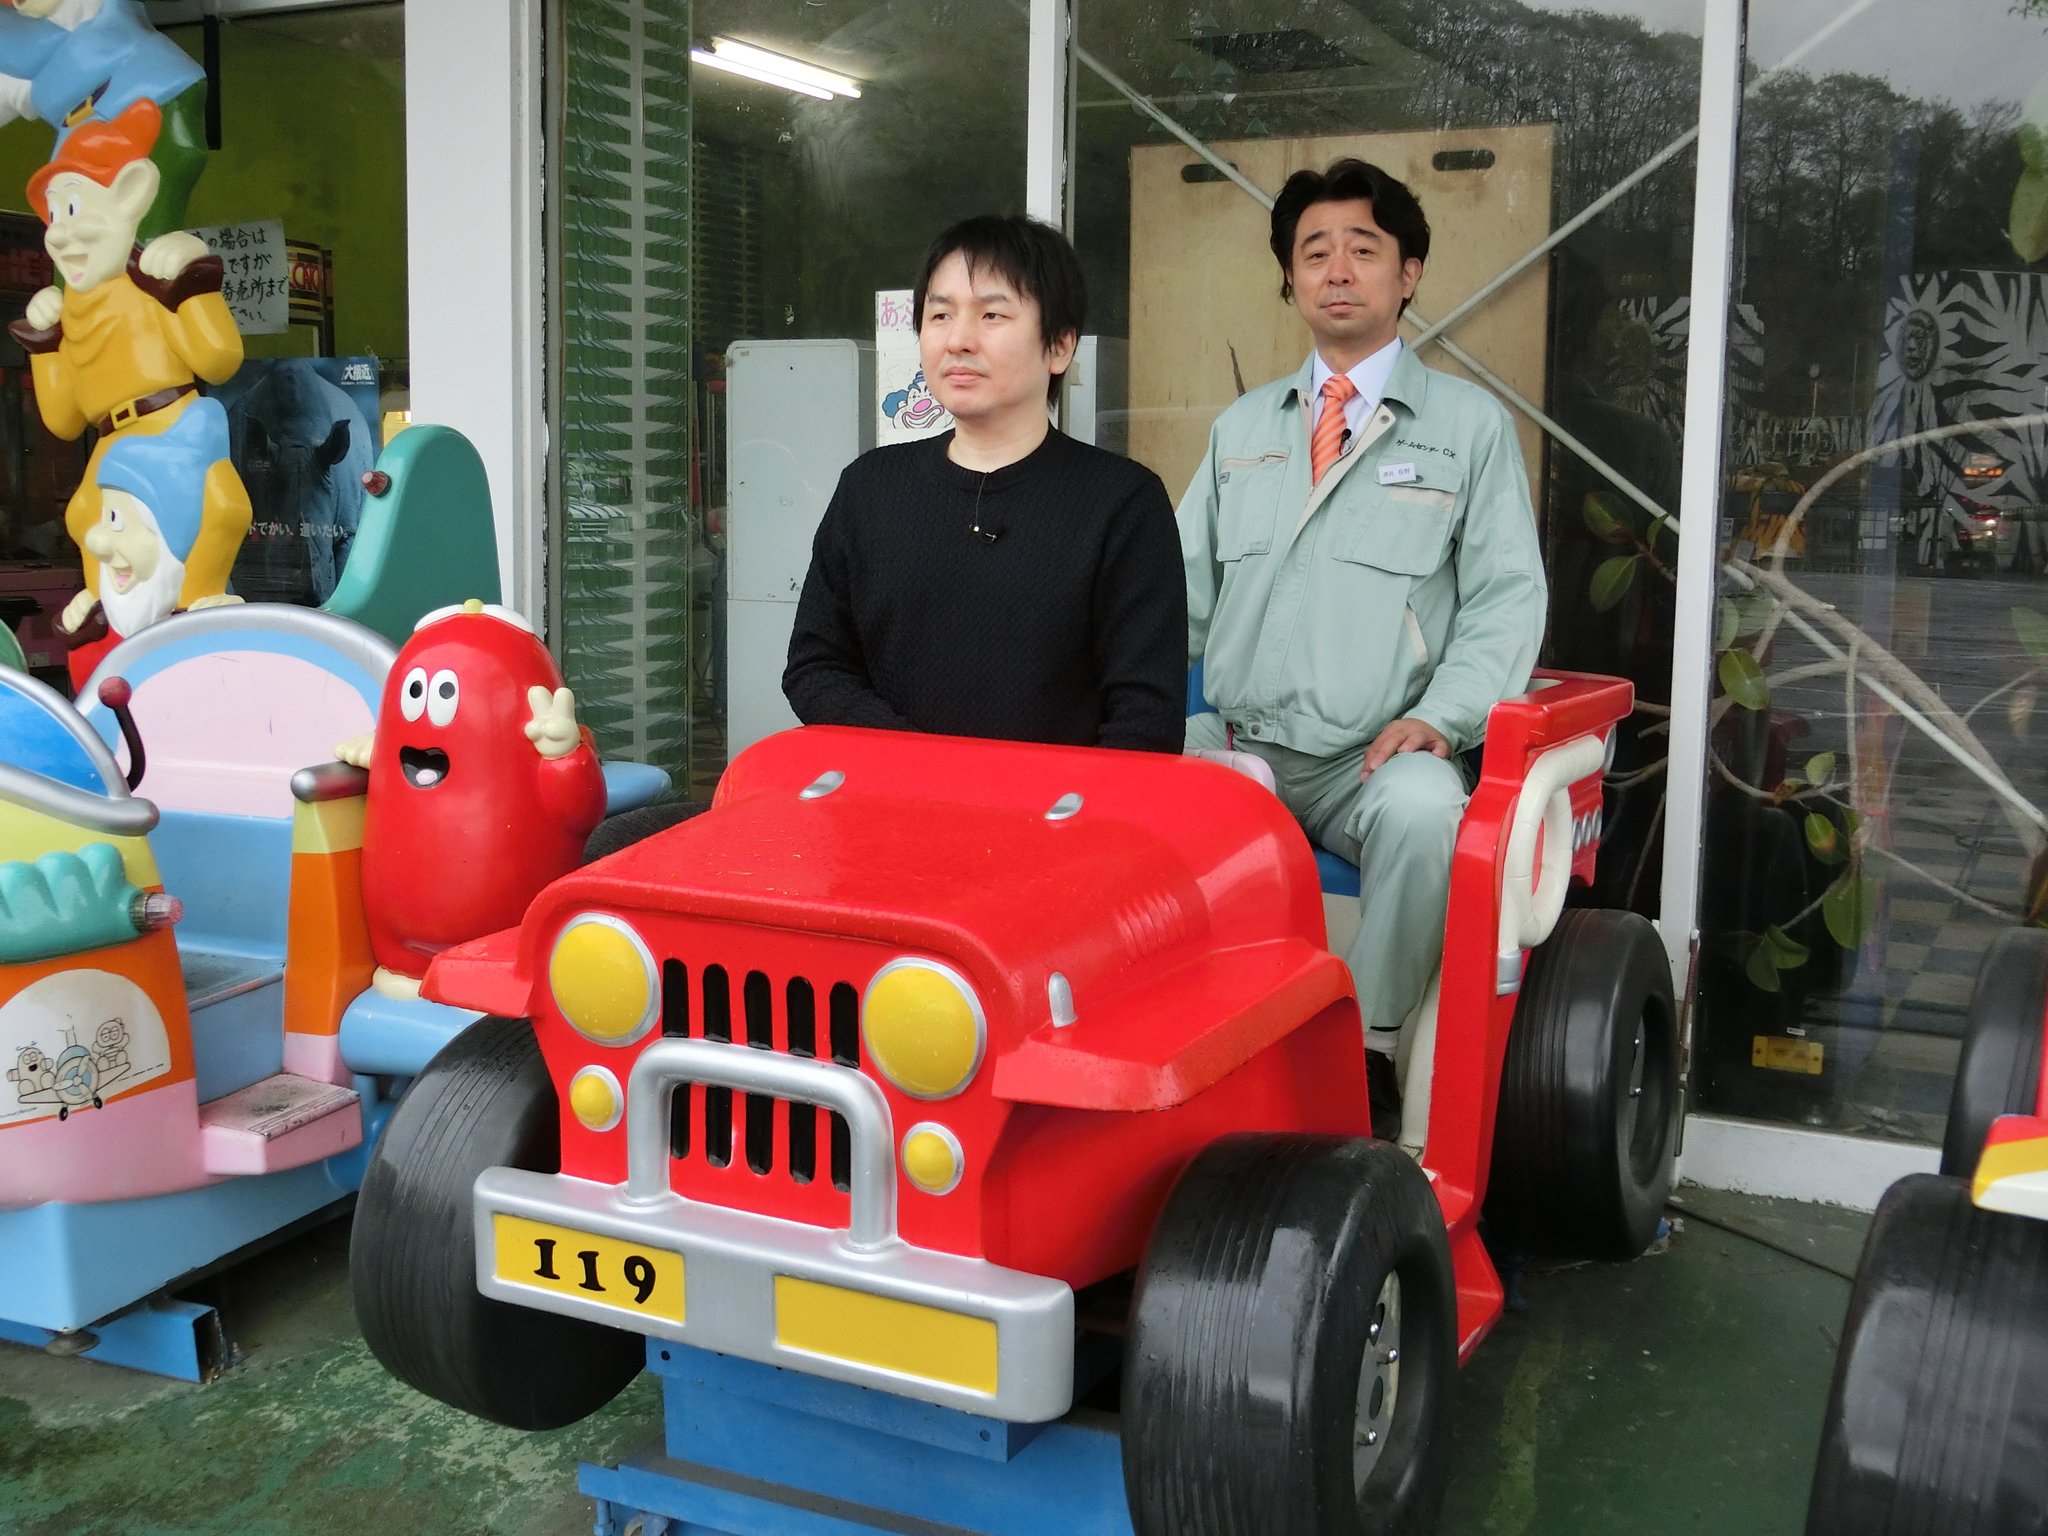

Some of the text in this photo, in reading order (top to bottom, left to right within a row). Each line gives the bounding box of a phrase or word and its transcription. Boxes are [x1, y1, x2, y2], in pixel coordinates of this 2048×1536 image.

[191, 227, 267, 250] の場合は
[224, 253, 272, 276] ですが
[533, 1238, 656, 1305] 119
